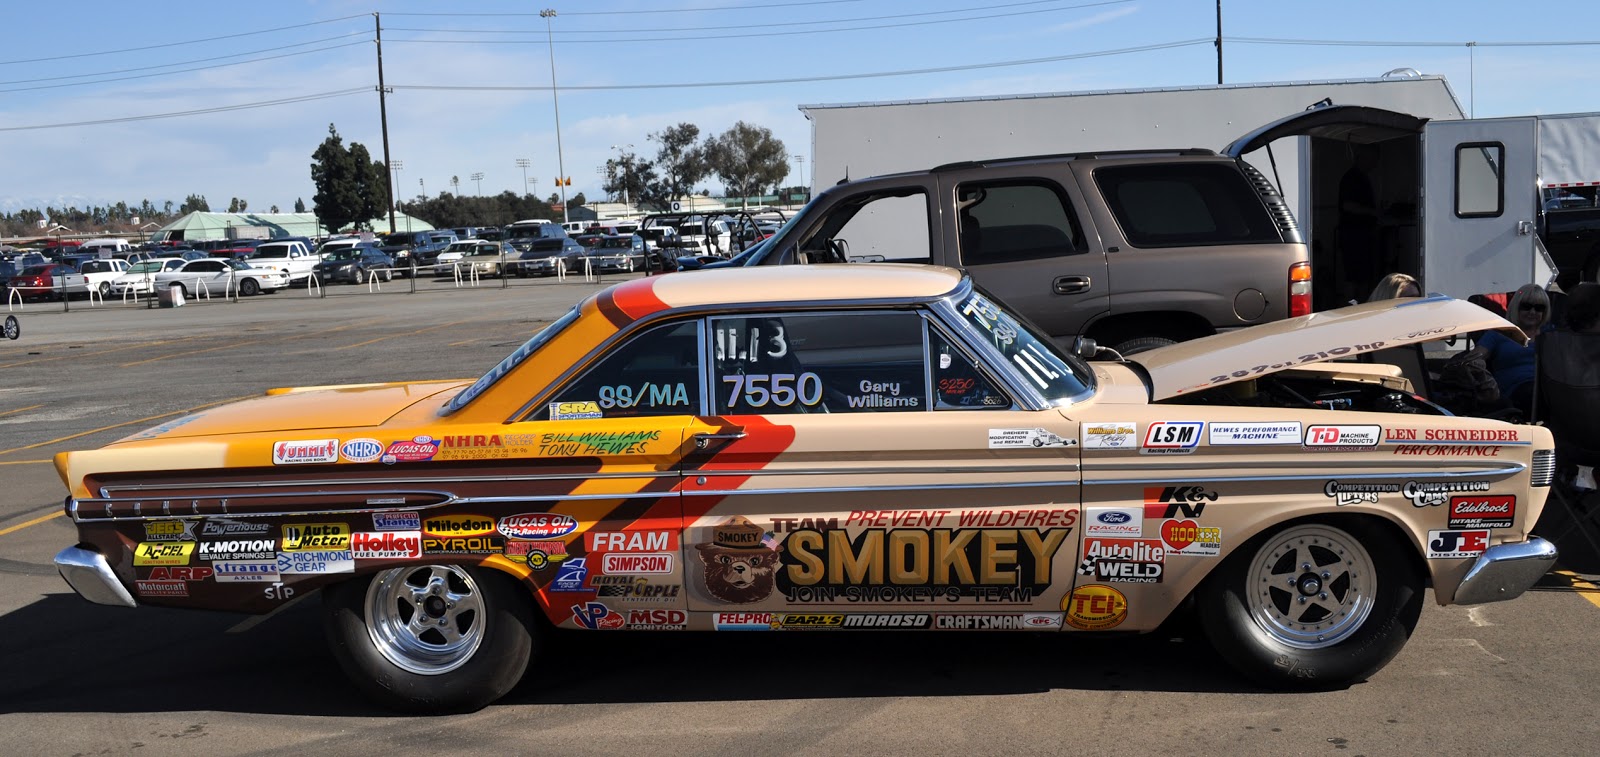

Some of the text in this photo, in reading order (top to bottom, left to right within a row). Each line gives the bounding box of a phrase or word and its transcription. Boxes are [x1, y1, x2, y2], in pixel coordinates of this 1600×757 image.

[1298, 346, 1352, 363] 210
[722, 372, 823, 408] 7550
[859, 380, 900, 396] Gary
[939, 378, 974, 391] 3250
[599, 382, 690, 409] SS/MA
[847, 394, 919, 408] Williams
[559, 402, 602, 414] SRA
[443, 435, 502, 447] NHRA
[541, 430, 662, 443] BILL WILLIAMS
[1152, 426, 1195, 442] LSM
[1311, 428, 1339, 443] T&D
[1385, 429, 1518, 441] LEN SCHNEIDER
[346, 442, 378, 457] NHRA
[389, 445, 434, 454] LUCAS OIL
[539, 442, 648, 456] TONY HEWES
[1393, 444, 1502, 457] PERFORMANCE
[1158, 486, 1219, 502] K&
[1325, 480, 1399, 496] COMPETITION
[1403, 481, 1490, 498] COMPETITION
[1337, 491, 1378, 505] LIFTERS
[1414, 491, 1449, 506] CAMS
[1163, 503, 1206, 518] N
[1455, 501, 1509, 513] Edelbrock
[375, 518, 419, 528] Strange
[501, 515, 574, 528] LUCAS OIL
[844, 509, 1079, 527] PREVENT WILDFIRES
[1103, 513, 1125, 522] Ford
[202, 521, 270, 536] Powerhouse
[303, 525, 340, 536] Auto
[427, 519, 492, 532] Milodon
[521, 528, 548, 536] Racing
[770, 518, 838, 533] TEAM
[300, 536, 347, 546] Meter
[592, 531, 669, 551] FRAM
[718, 531, 759, 543] SMOKEY
[1170, 527, 1220, 543] HOOKER
[1430, 531, 1487, 552] JE
[143, 543, 184, 559] ACCEL
[199, 540, 275, 553] K-MOTION
[353, 533, 418, 557] Holley
[423, 538, 503, 550] PYROIL
[1088, 540, 1164, 562] Autolite
[293, 551, 353, 562] RICHMOND
[608, 556, 667, 571] SIMPSON
[784, 528, 1073, 586] SMOKEY
[148, 566, 213, 581] ARP
[214, 563, 278, 573] Strange
[295, 562, 326, 572] GEAR
[1099, 563, 1162, 577] WELD
[138, 582, 186, 591] Motorcraft
[592, 575, 635, 585] ROYAL
[264, 583, 294, 599] STP
[623, 584, 681, 597] PURPLE
[786, 587, 1032, 602] JOIN SMOKEY'S TEAM
[1073, 594, 1115, 613] TCI
[571, 602, 609, 629] VP
[599, 617, 622, 627] Racing
[630, 610, 686, 624] MSD
[718, 613, 772, 624] FEL-PRO
[784, 615, 842, 624] EARL'S
[844, 614, 929, 627] MOROSO
[936, 615, 1023, 629] CRAFTSMAN
[1074, 612, 1116, 620] TRANSMISSION
